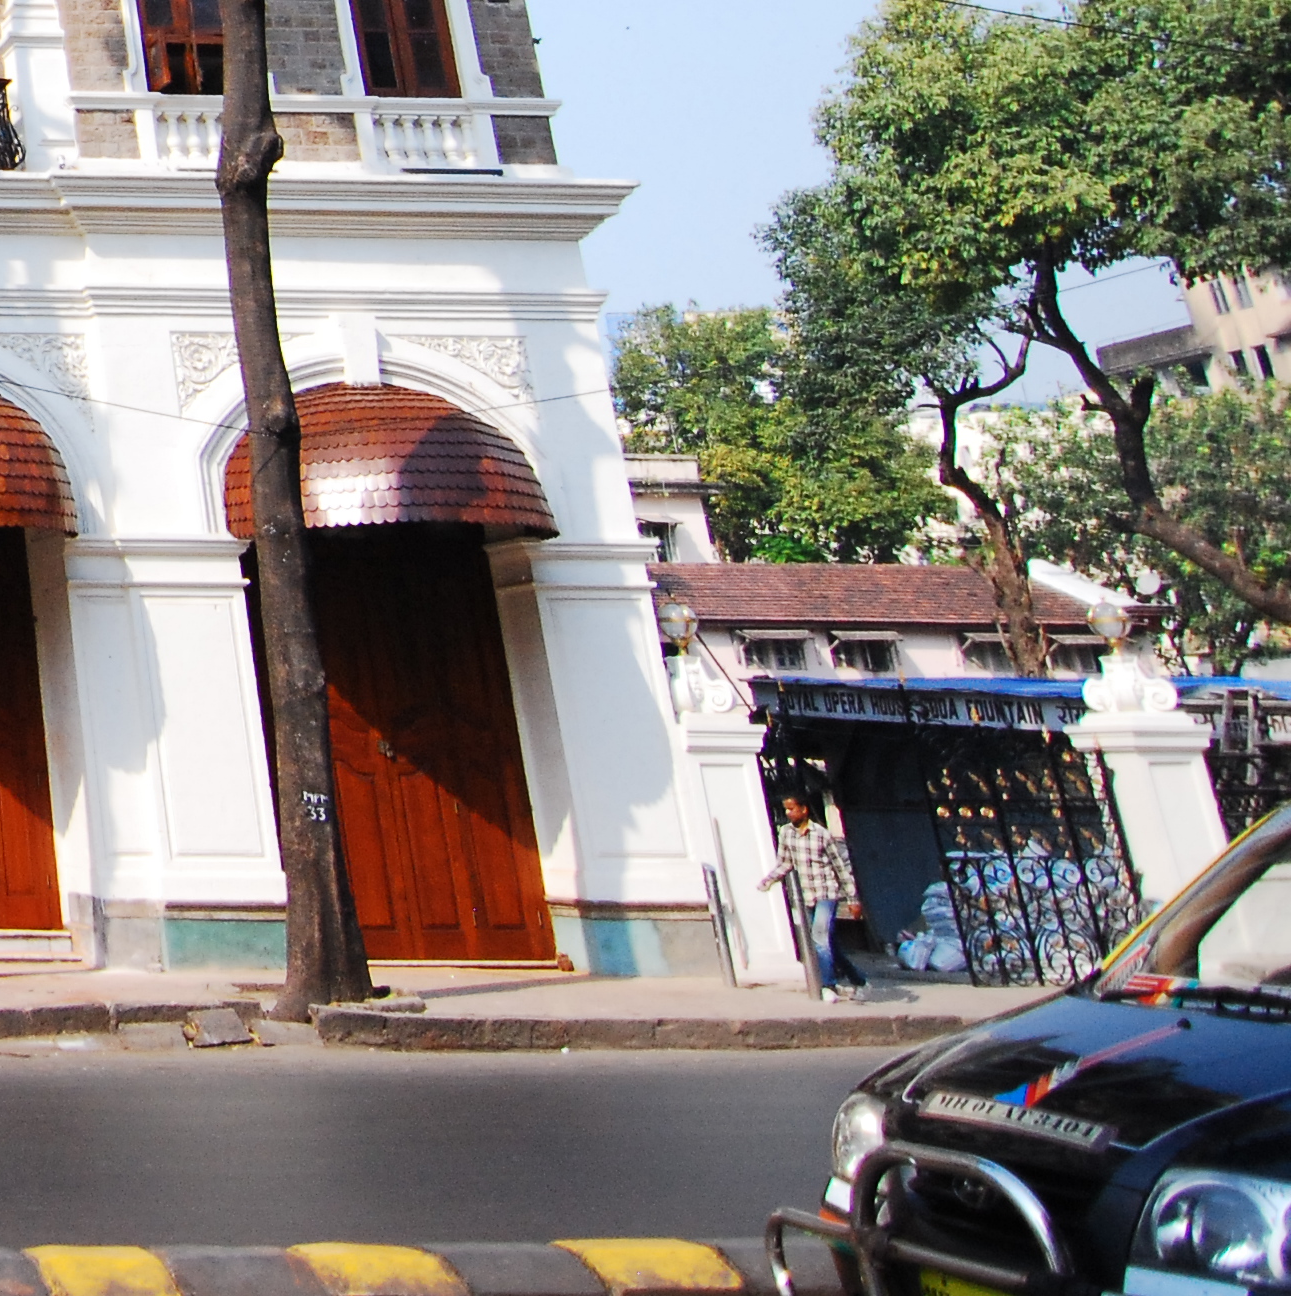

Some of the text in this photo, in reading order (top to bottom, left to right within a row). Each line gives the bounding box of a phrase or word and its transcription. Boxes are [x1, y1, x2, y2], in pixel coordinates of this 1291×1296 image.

[822, 691, 866, 715] OPERA
[869, 694, 907, 718] HOUS
[307, 805, 326, 821] 33
